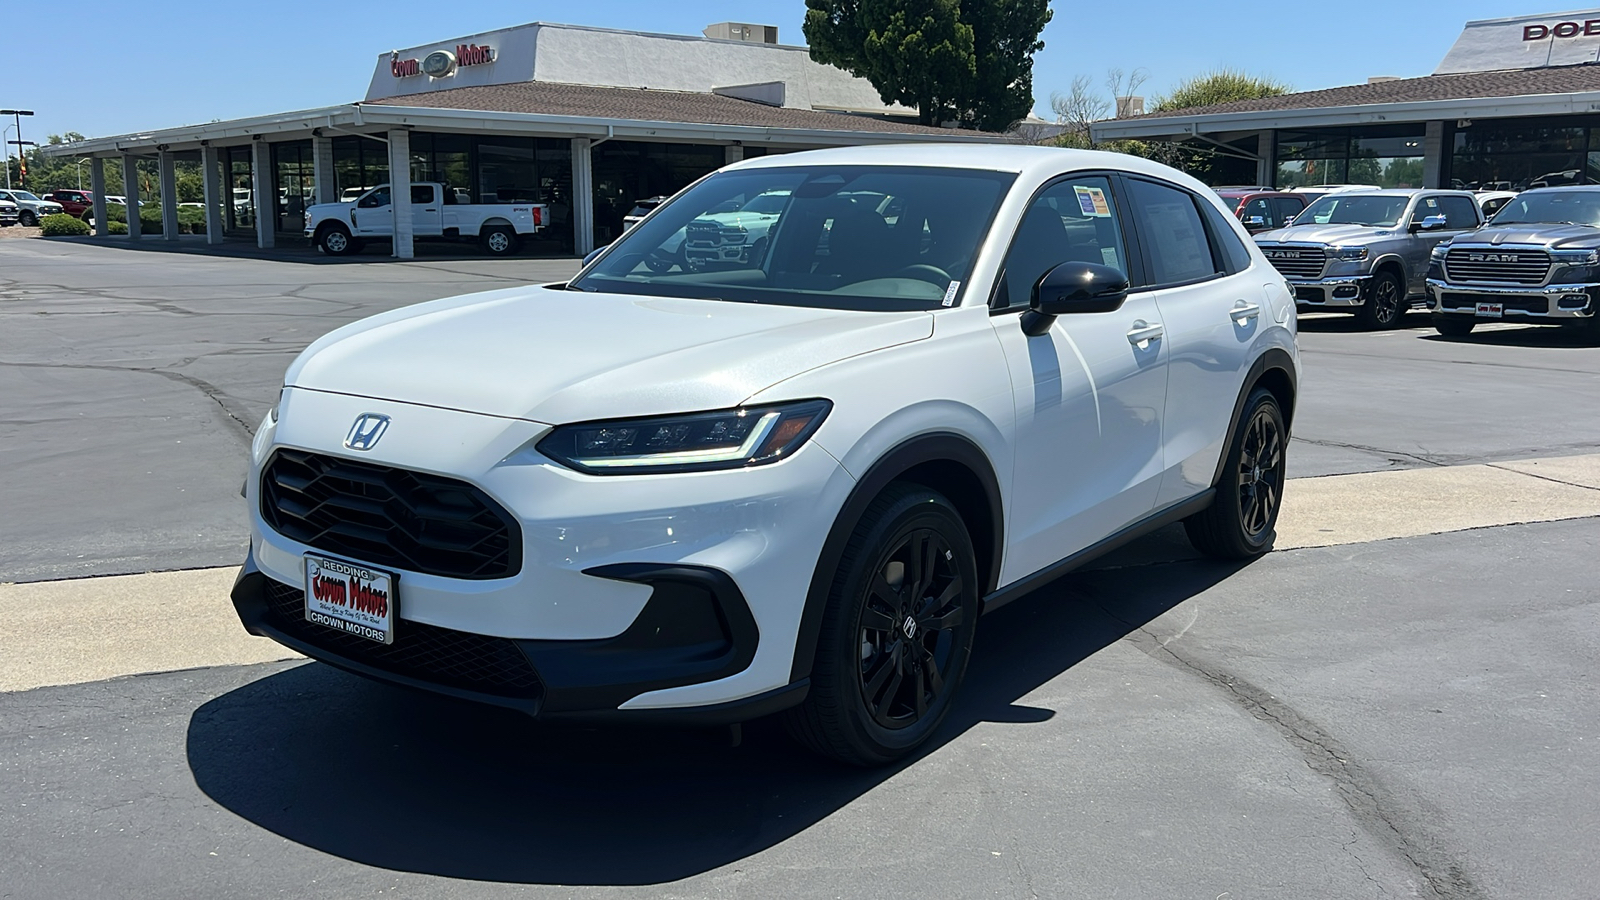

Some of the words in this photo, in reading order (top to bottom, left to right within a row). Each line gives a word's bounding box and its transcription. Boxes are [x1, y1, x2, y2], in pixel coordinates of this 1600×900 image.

[391, 57, 419, 78] Crown
[456, 43, 491, 67] Motors
[1469, 254, 1518, 262] RAM
[323, 561, 369, 579] REDDING
[312, 569, 347, 607] Crown
[349, 576, 388, 618] Motors
[311, 612, 344, 629] CROWN
[346, 622, 385, 641] MOTORS
